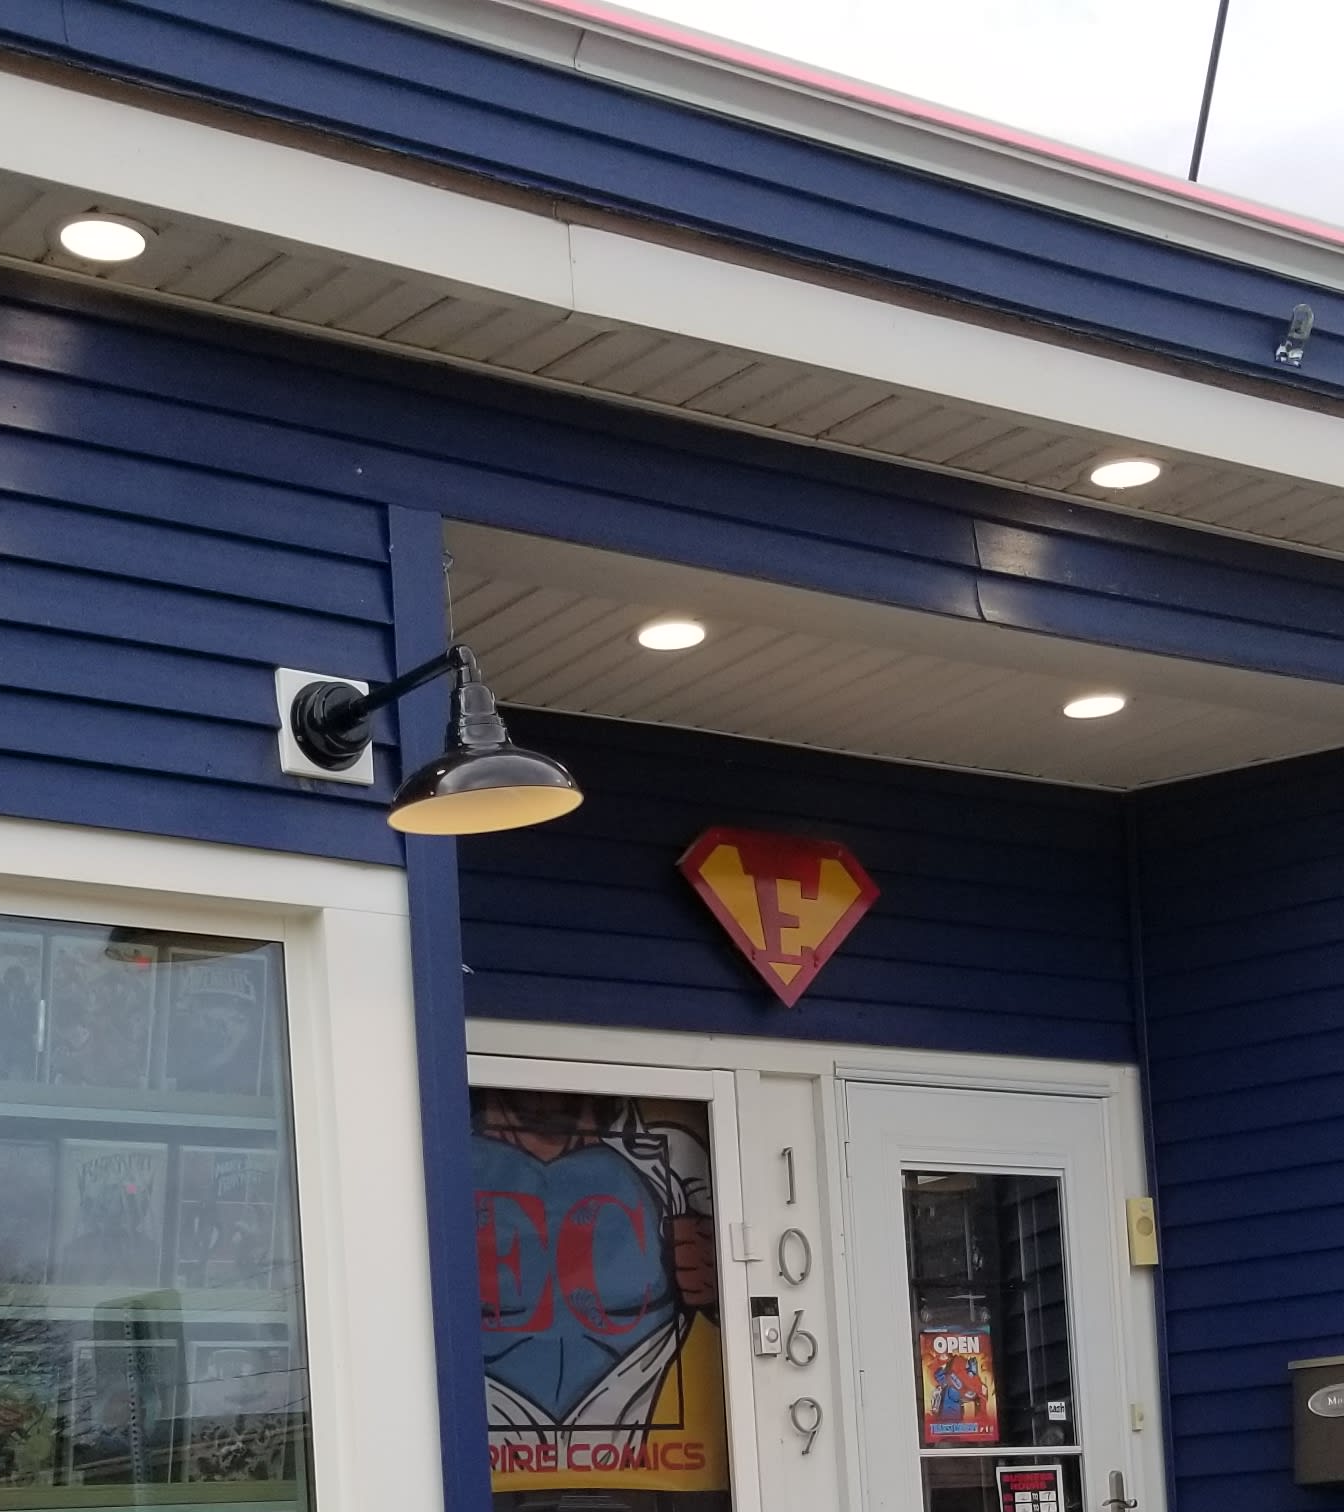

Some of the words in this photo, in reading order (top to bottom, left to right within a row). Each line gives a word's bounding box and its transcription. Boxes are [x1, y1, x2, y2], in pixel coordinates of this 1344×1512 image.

[474, 1190, 654, 1336] EC
[779, 1146, 824, 1456] 1069
[933, 1336, 980, 1355] OPEN
[567, 1442, 706, 1472] COMICS
